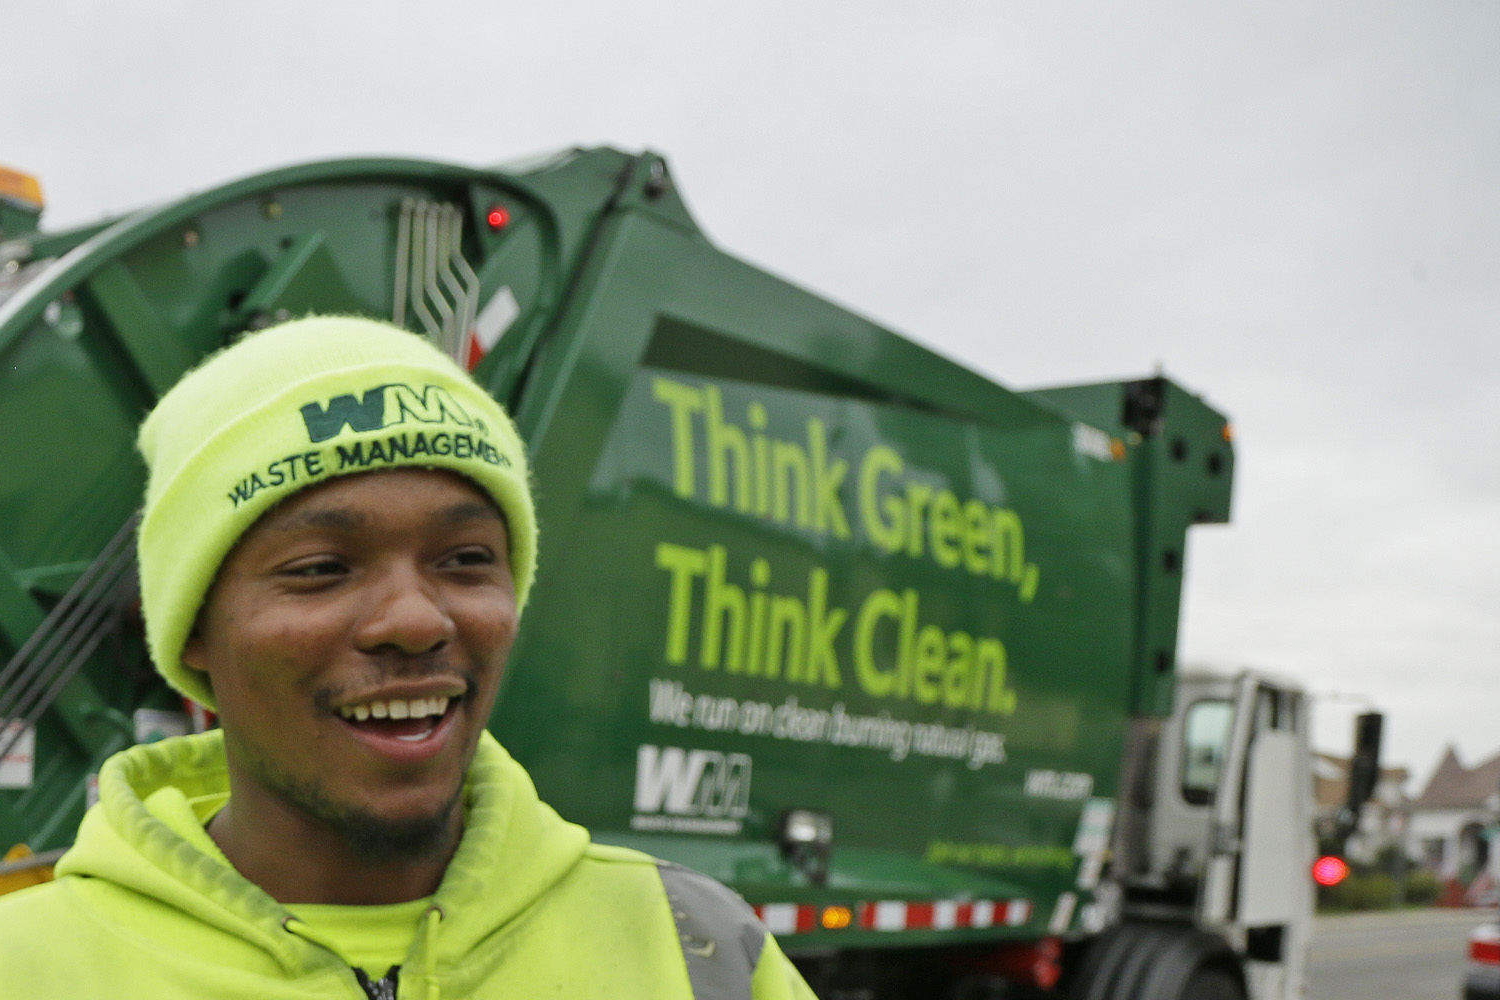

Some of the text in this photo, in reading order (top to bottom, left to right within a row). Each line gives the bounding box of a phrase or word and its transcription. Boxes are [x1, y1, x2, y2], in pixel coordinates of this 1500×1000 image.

[301, 384, 474, 443] WM
[228, 451, 324, 508] WASTE
[652, 376, 1040, 604] Think Green,
[655, 542, 1017, 715] Think Clean.
[649, 678, 694, 728] We
[692, 694, 739, 733] run
[738, 700, 774, 735] on
[772, 695, 831, 741] clean
[830, 702, 912, 762] burning
[634, 744, 752, 818] WM
